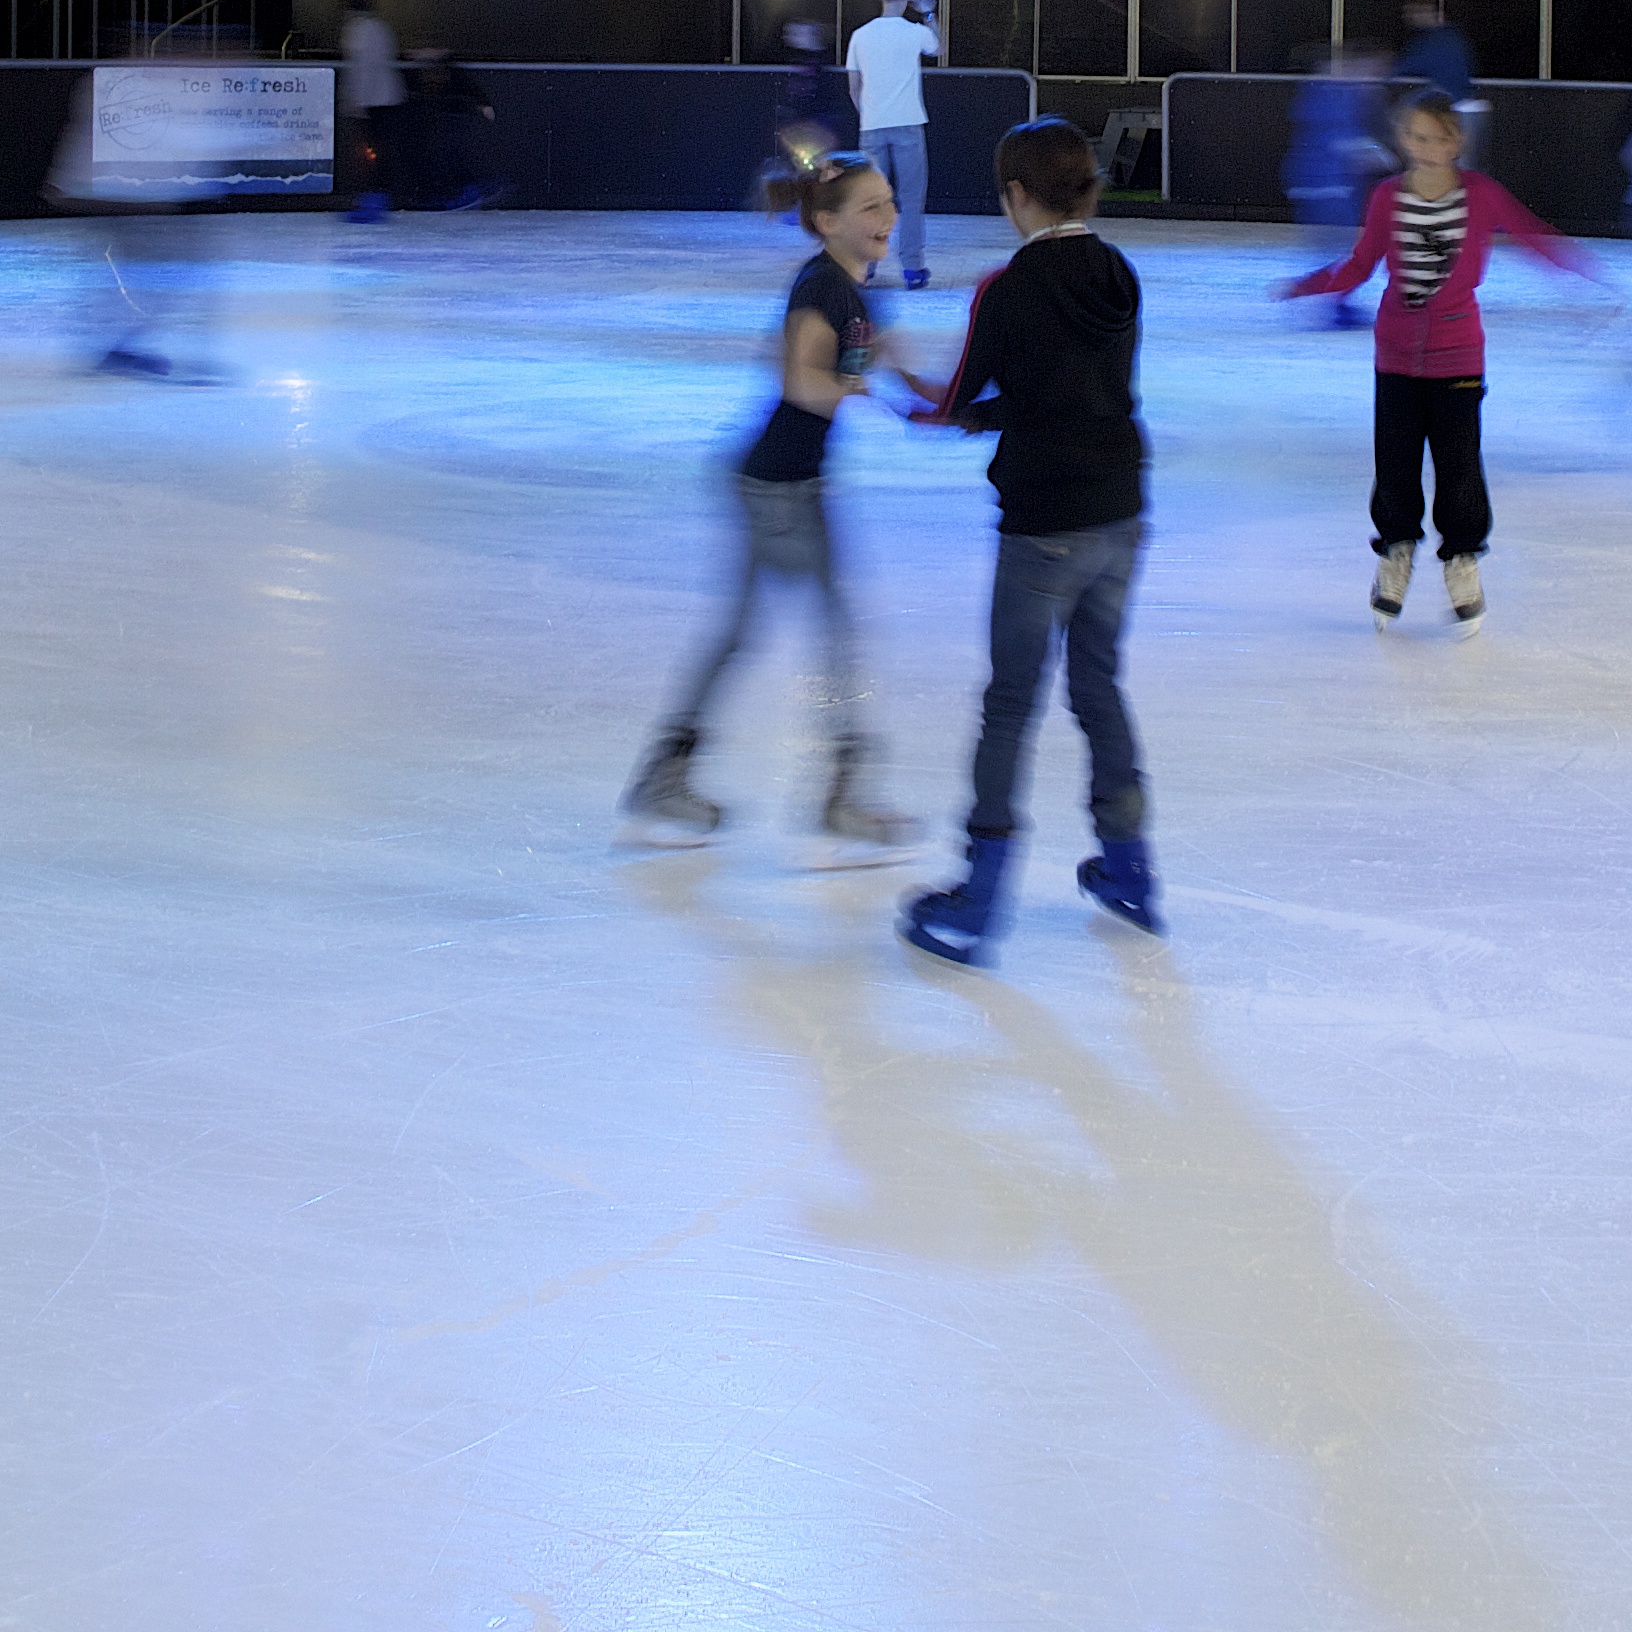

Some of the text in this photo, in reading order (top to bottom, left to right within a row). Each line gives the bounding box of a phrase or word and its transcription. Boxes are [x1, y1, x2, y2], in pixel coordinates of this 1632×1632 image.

[180, 77, 307, 93] Ice Re:fresh
[258, 108, 288, 118] range
[292, 107, 303, 116] of
